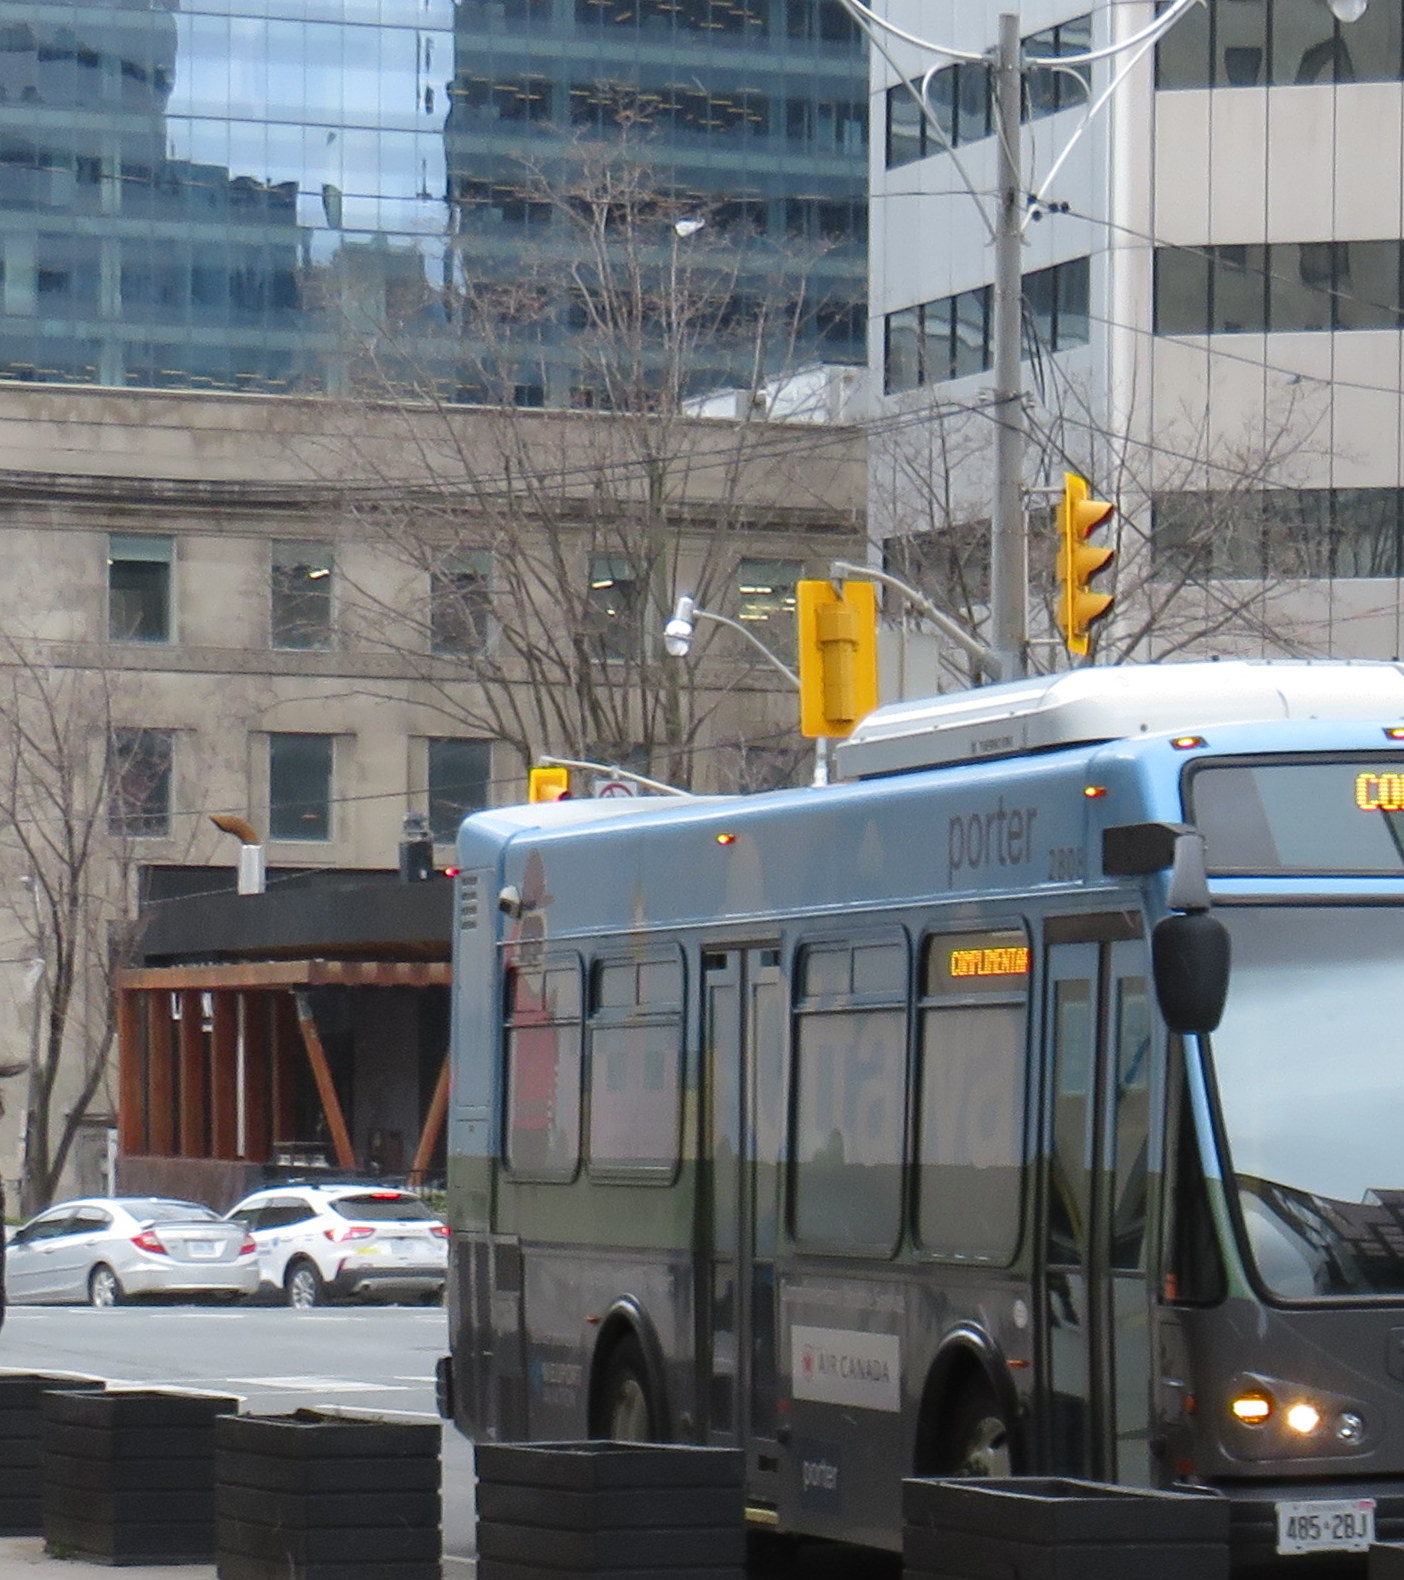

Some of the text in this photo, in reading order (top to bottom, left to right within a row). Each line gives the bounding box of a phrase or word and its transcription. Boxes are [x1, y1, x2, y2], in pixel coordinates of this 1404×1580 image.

[948, 794, 1038, 889] porter
[817, 1352, 892, 1383] AIR CANADA
